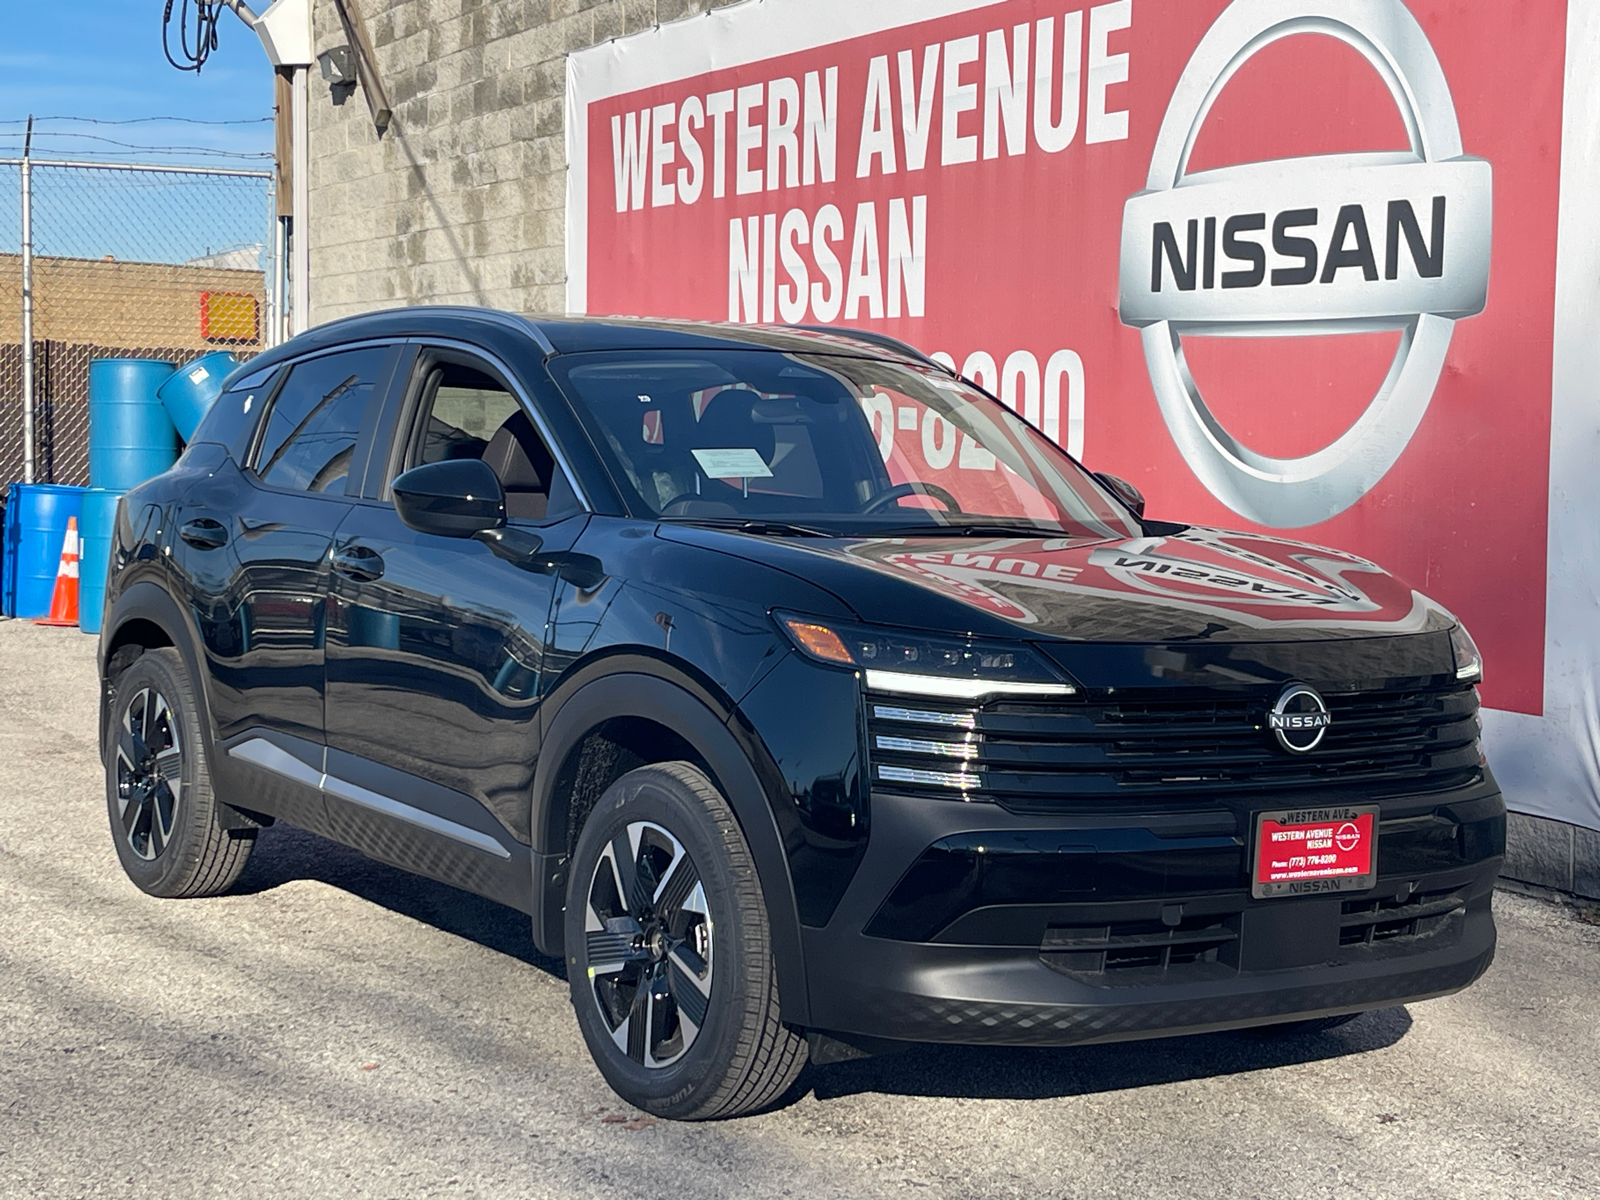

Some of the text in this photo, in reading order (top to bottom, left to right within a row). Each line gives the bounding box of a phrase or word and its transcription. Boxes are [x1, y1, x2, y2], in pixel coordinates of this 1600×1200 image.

[611, 0, 1132, 213] WESTERN AVENUE
[1151, 195, 1446, 292] NISSAN
[728, 195, 927, 324] NISSAN
[1271, 714, 1331, 728] NISSAN
[1287, 810, 1330, 823] WESTERN
[1271, 828, 1333, 842] WESTERN AVENUE
[1306, 838, 1332, 850] NISSAN
[1289, 880, 1340, 893] NISSAN
